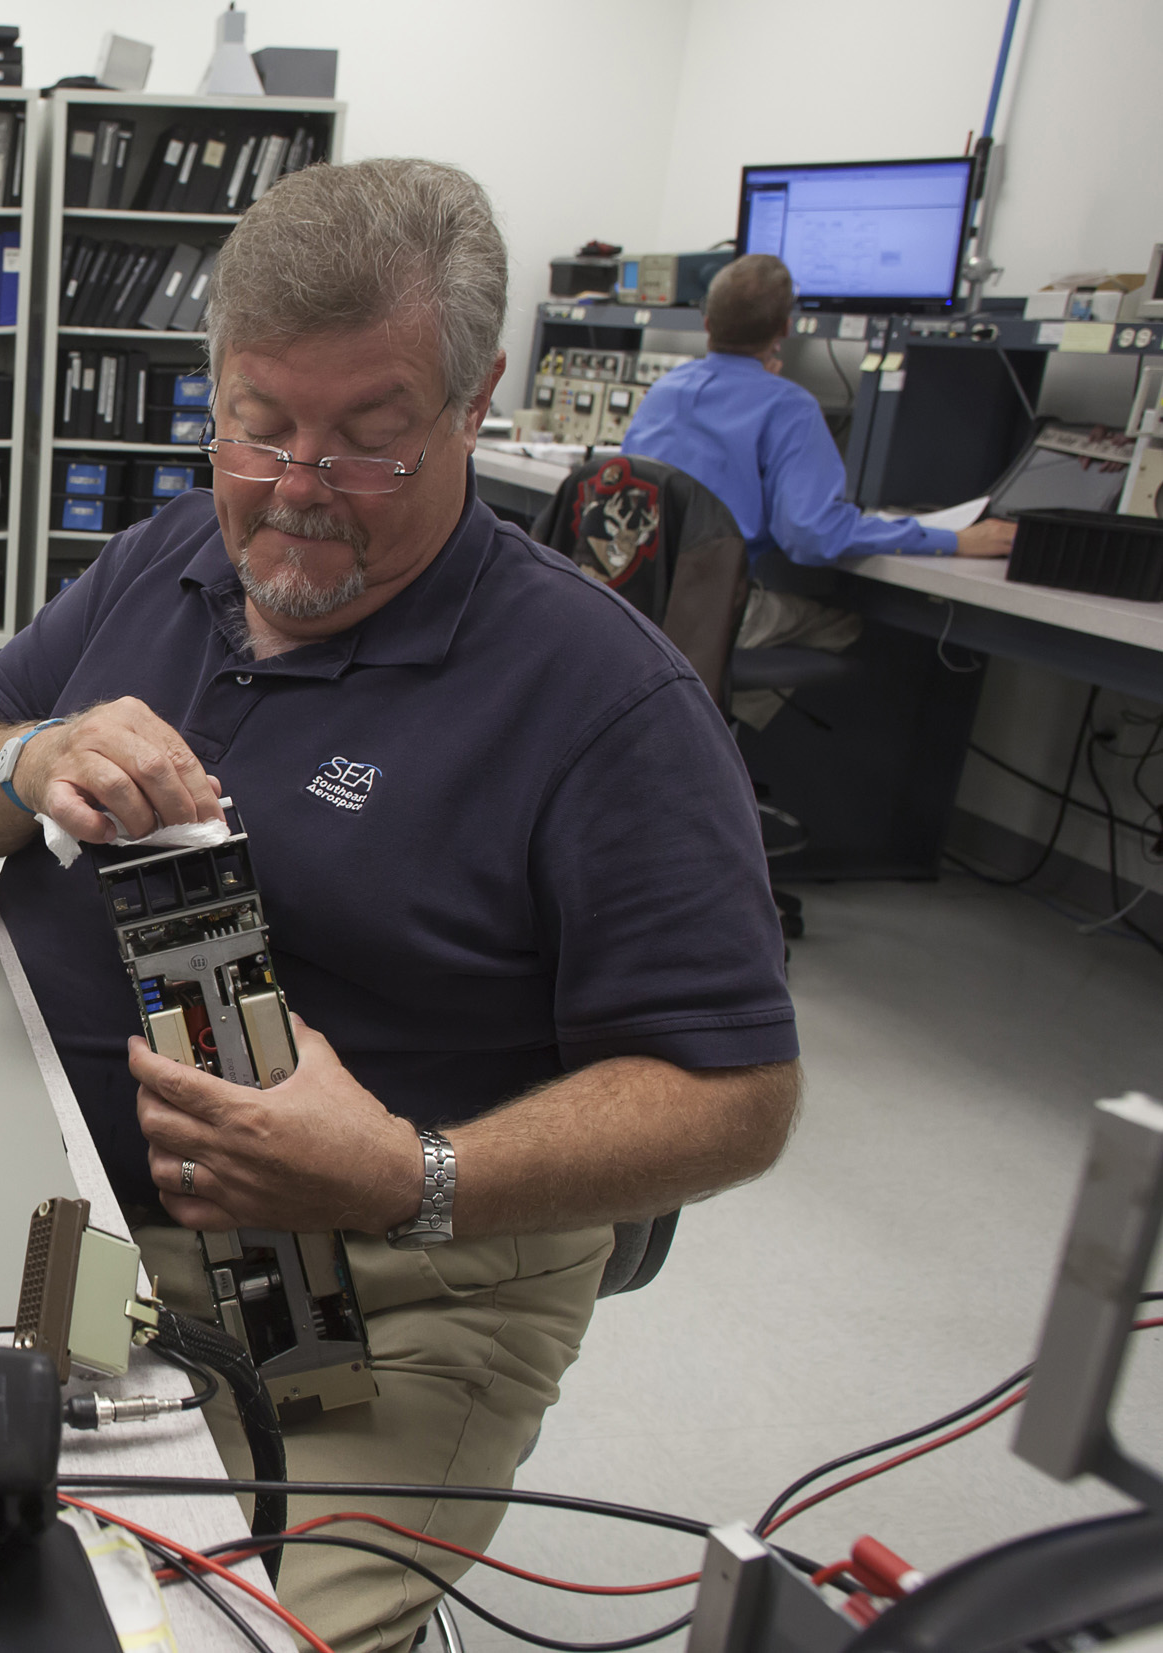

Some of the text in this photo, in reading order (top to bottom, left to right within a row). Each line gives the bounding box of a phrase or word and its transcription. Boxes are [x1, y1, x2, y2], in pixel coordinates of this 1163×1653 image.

[324, 756, 376, 792] SEA
[306, 784, 363, 811] Aerospace
[312, 775, 368, 803] Southeast
